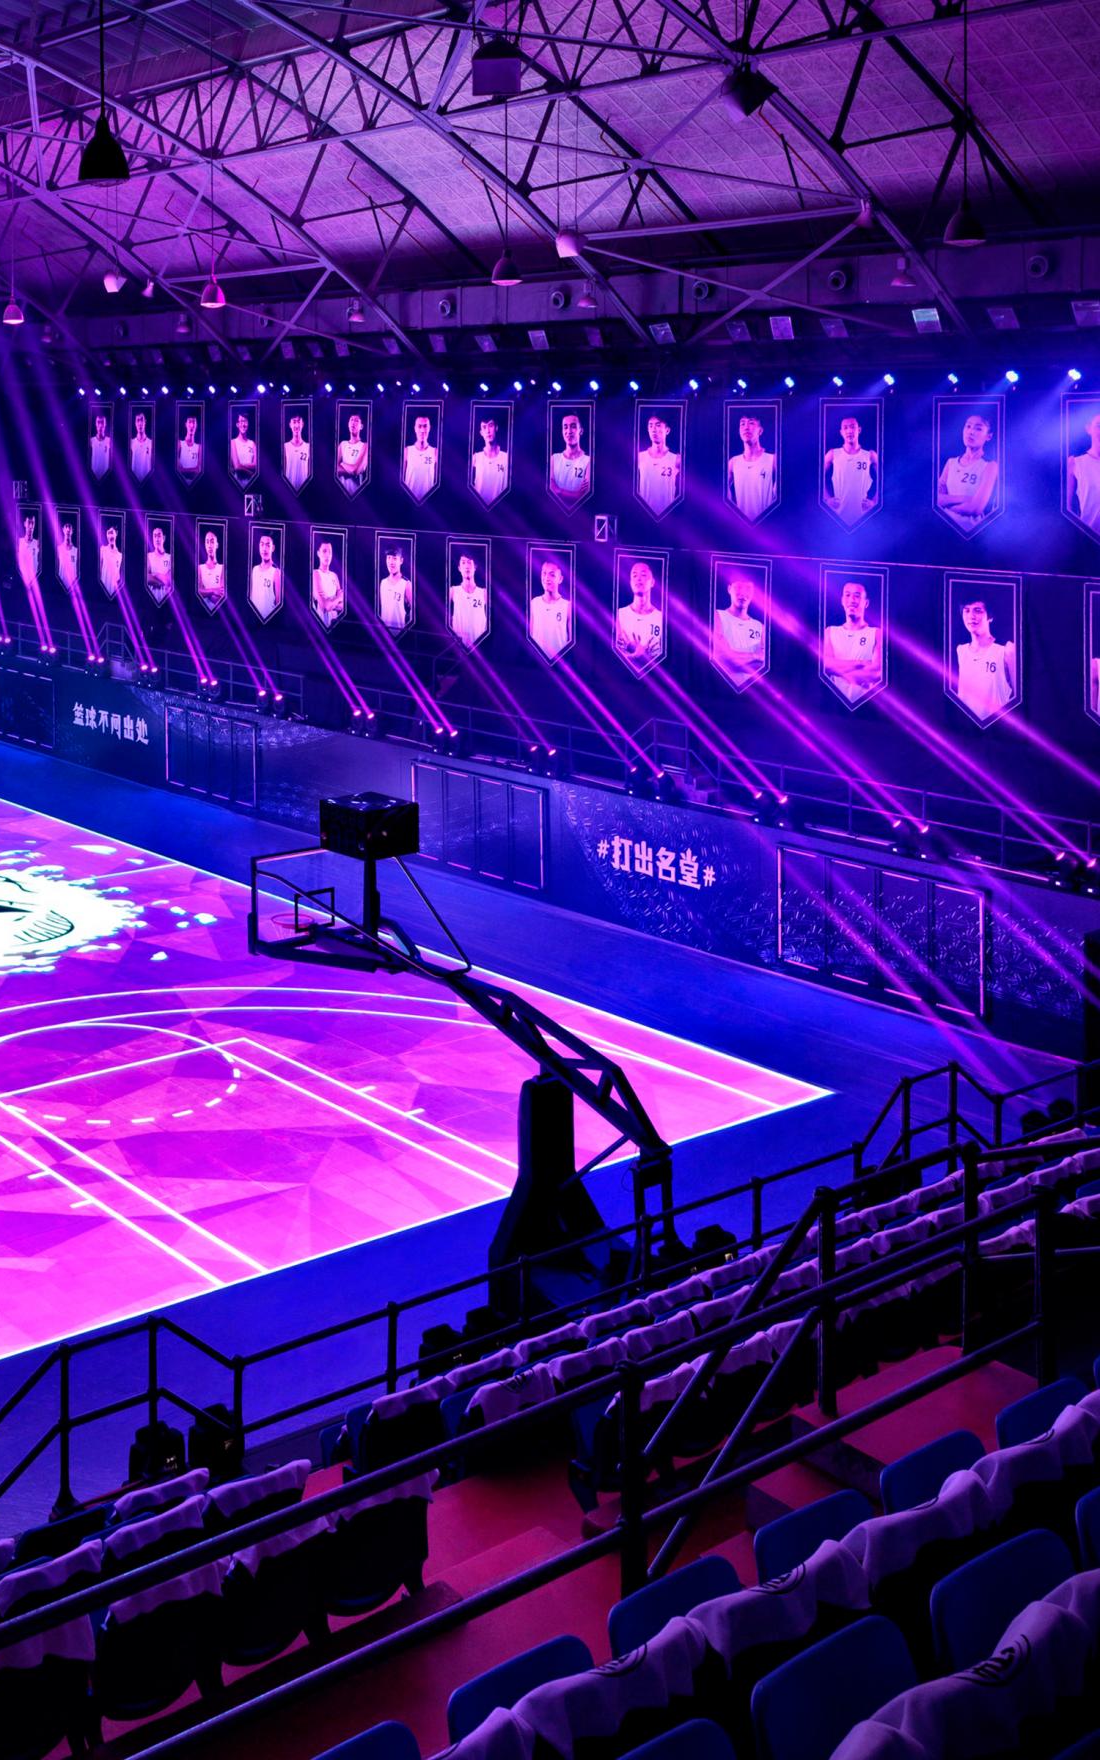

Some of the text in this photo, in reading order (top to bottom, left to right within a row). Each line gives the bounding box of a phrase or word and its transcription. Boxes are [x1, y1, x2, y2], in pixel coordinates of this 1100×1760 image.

[299, 452, 307, 461] 22
[497, 463, 504, 472] 14
[856, 461, 867, 470] 30
[574, 467, 583, 478] 12
[661, 467, 673, 477] 23
[760, 469, 766, 479] 4
[473, 598, 482, 608] 24
[556, 612, 562, 621] 6
[650, 623, 660, 636] 18
[859, 636, 866, 646] 8
[986, 661, 997, 673] 16
[72, 702, 149, 745] 篮球不问出处
[597, 835, 717, 890] #打出名堂#
